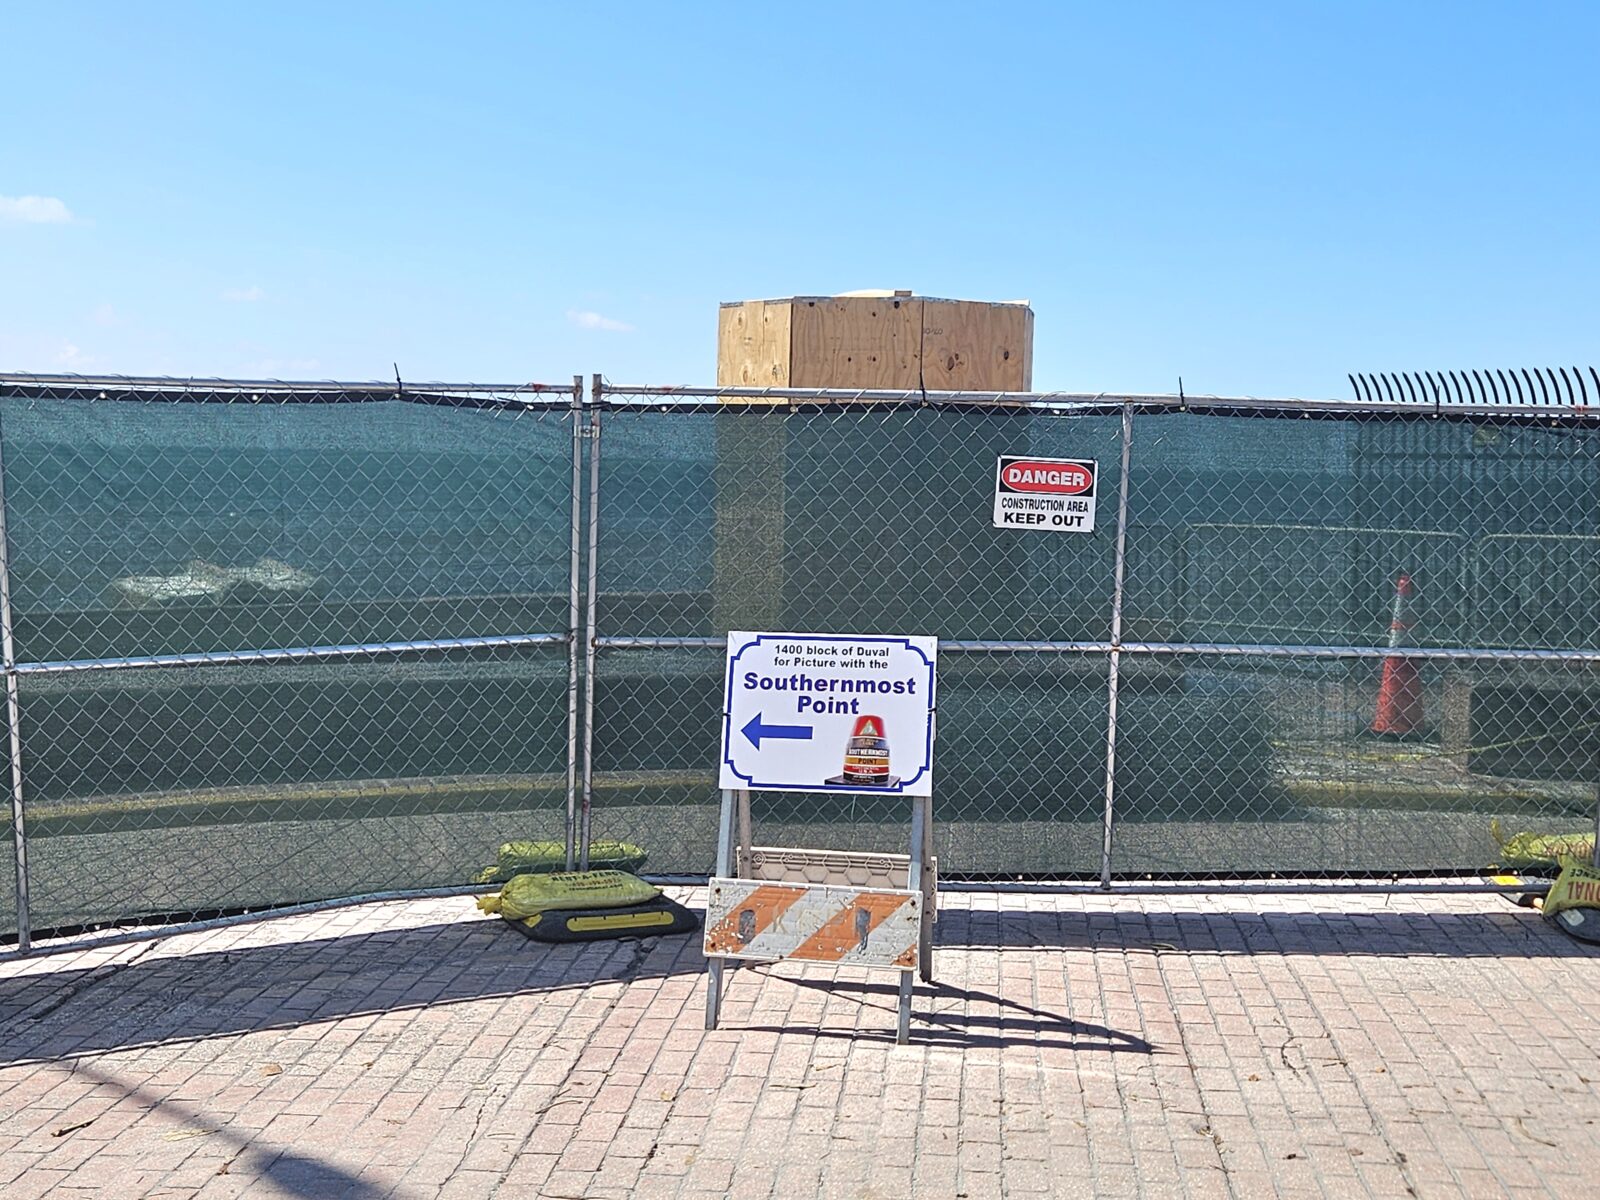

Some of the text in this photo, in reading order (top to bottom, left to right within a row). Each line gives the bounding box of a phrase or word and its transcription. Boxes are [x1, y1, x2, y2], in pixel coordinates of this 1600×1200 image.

[1009, 468, 1085, 486] DANGER
[1001, 497, 1089, 513] CONSTRUCTION AREA
[1003, 512, 1085, 527] KEEP OUT
[774, 644, 890, 657] 1400 block of Duval
[774, 656, 888, 669] for Picture with the
[743, 672, 916, 694] Southernmost
[797, 695, 860, 714] Point
